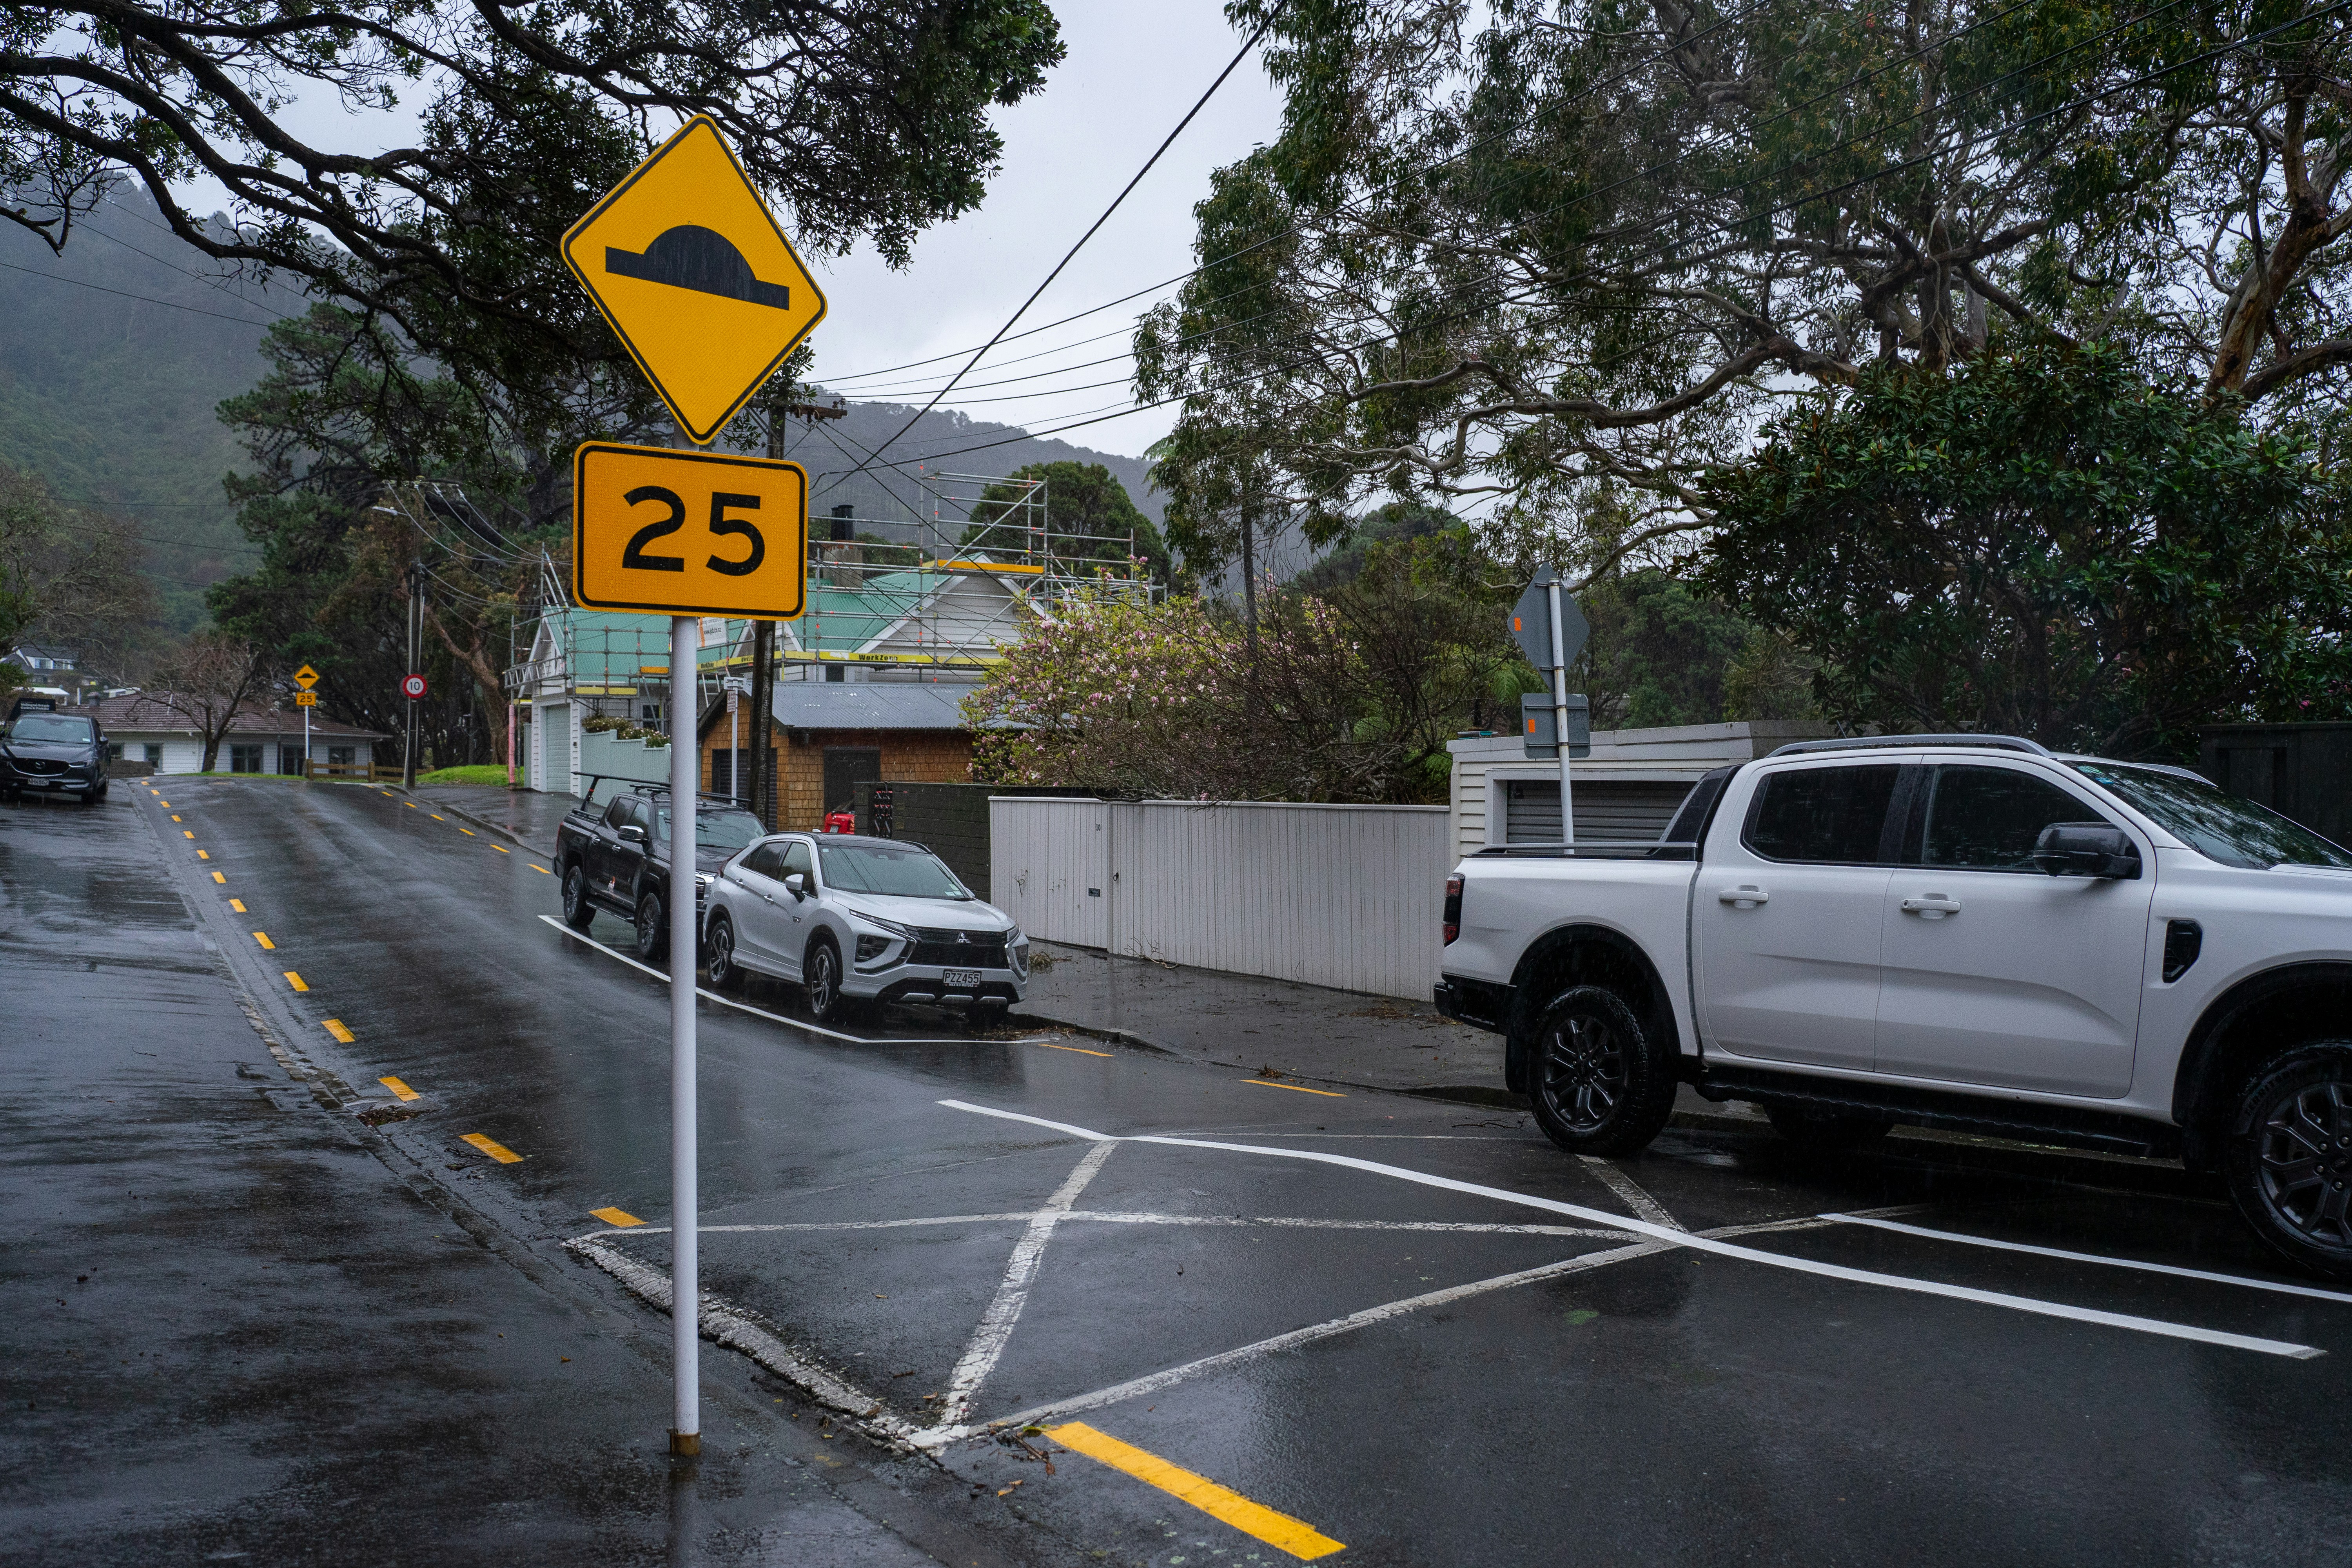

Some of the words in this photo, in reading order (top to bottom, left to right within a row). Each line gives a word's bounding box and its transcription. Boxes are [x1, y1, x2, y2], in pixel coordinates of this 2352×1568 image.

[622, 486, 765, 576] 25
[410, 682, 420, 690] 10
[944, 973, 979, 983] PZZ455
